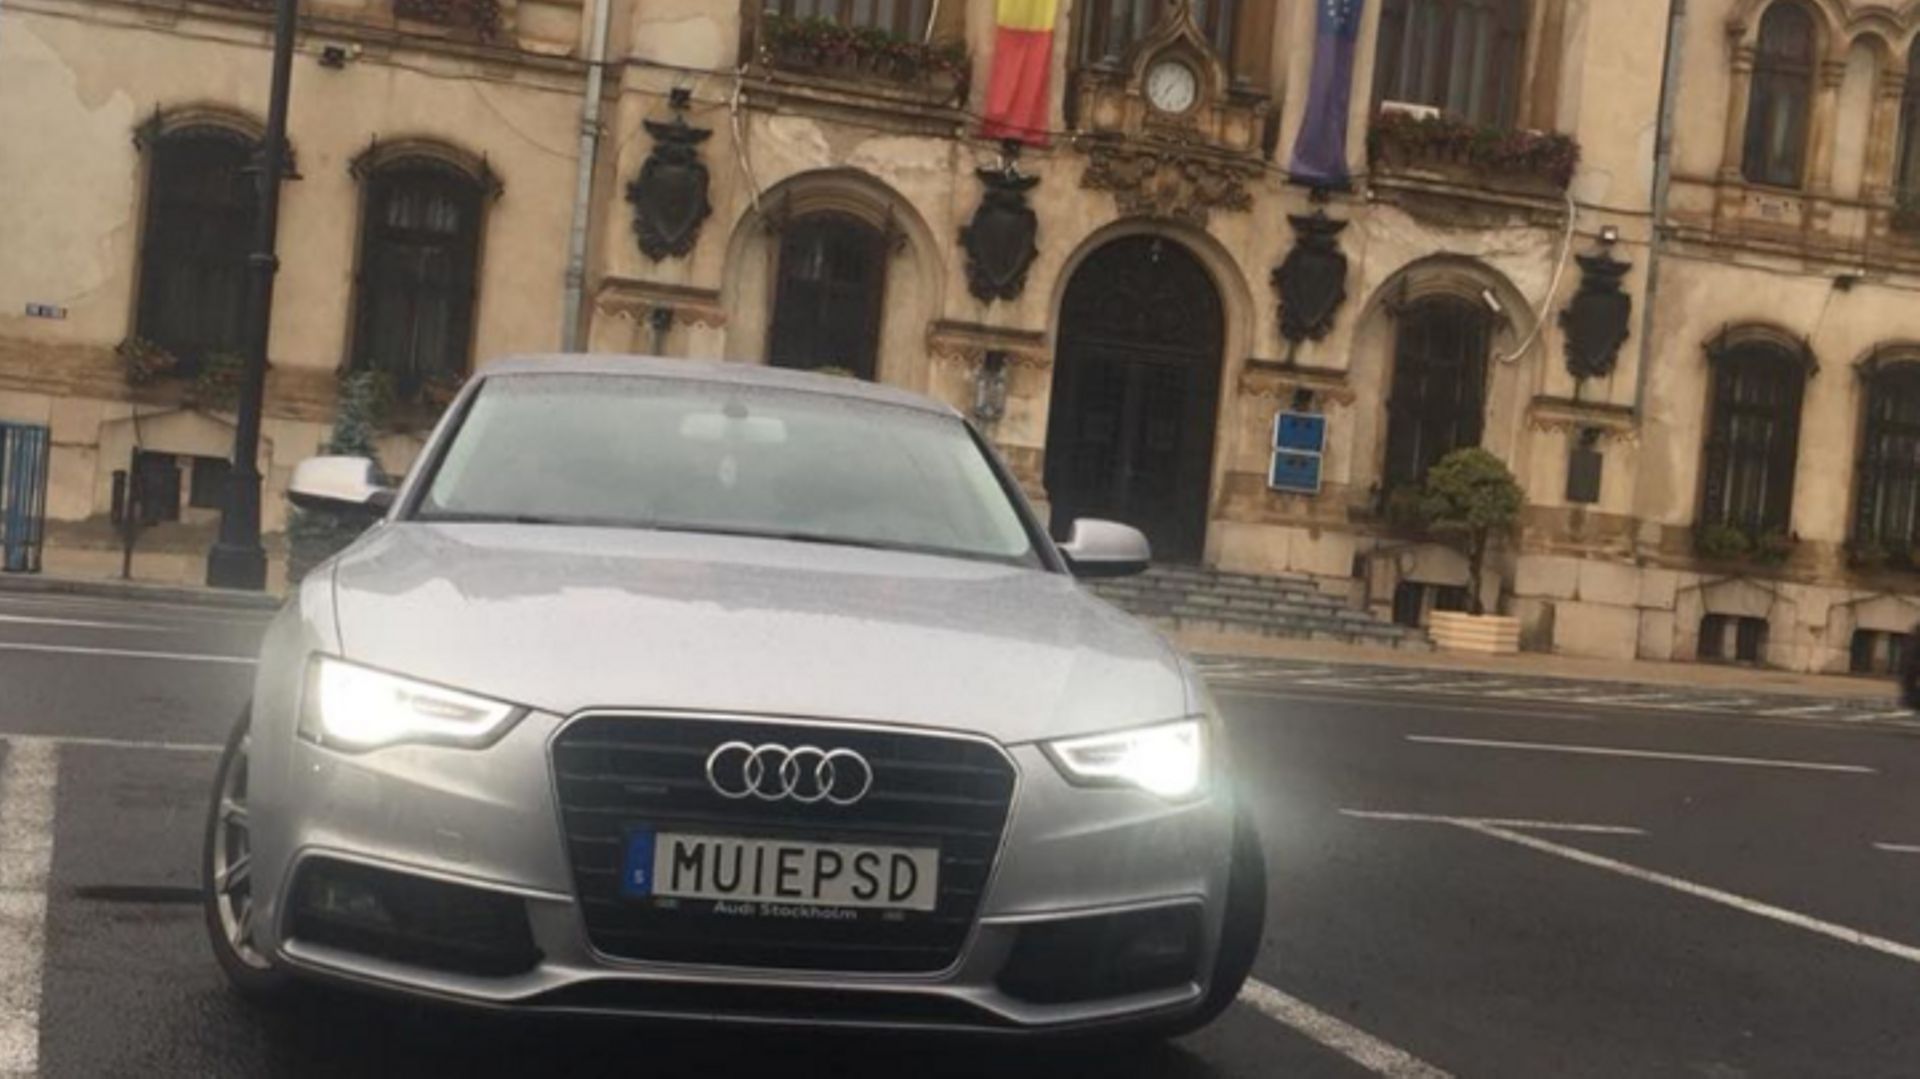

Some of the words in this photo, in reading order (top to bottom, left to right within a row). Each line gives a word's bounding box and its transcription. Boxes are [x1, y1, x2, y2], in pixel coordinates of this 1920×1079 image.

[671, 841, 918, 902] MUIEPSD
[713, 901, 755, 916] Audi
[760, 903, 858, 919] Stockholm
